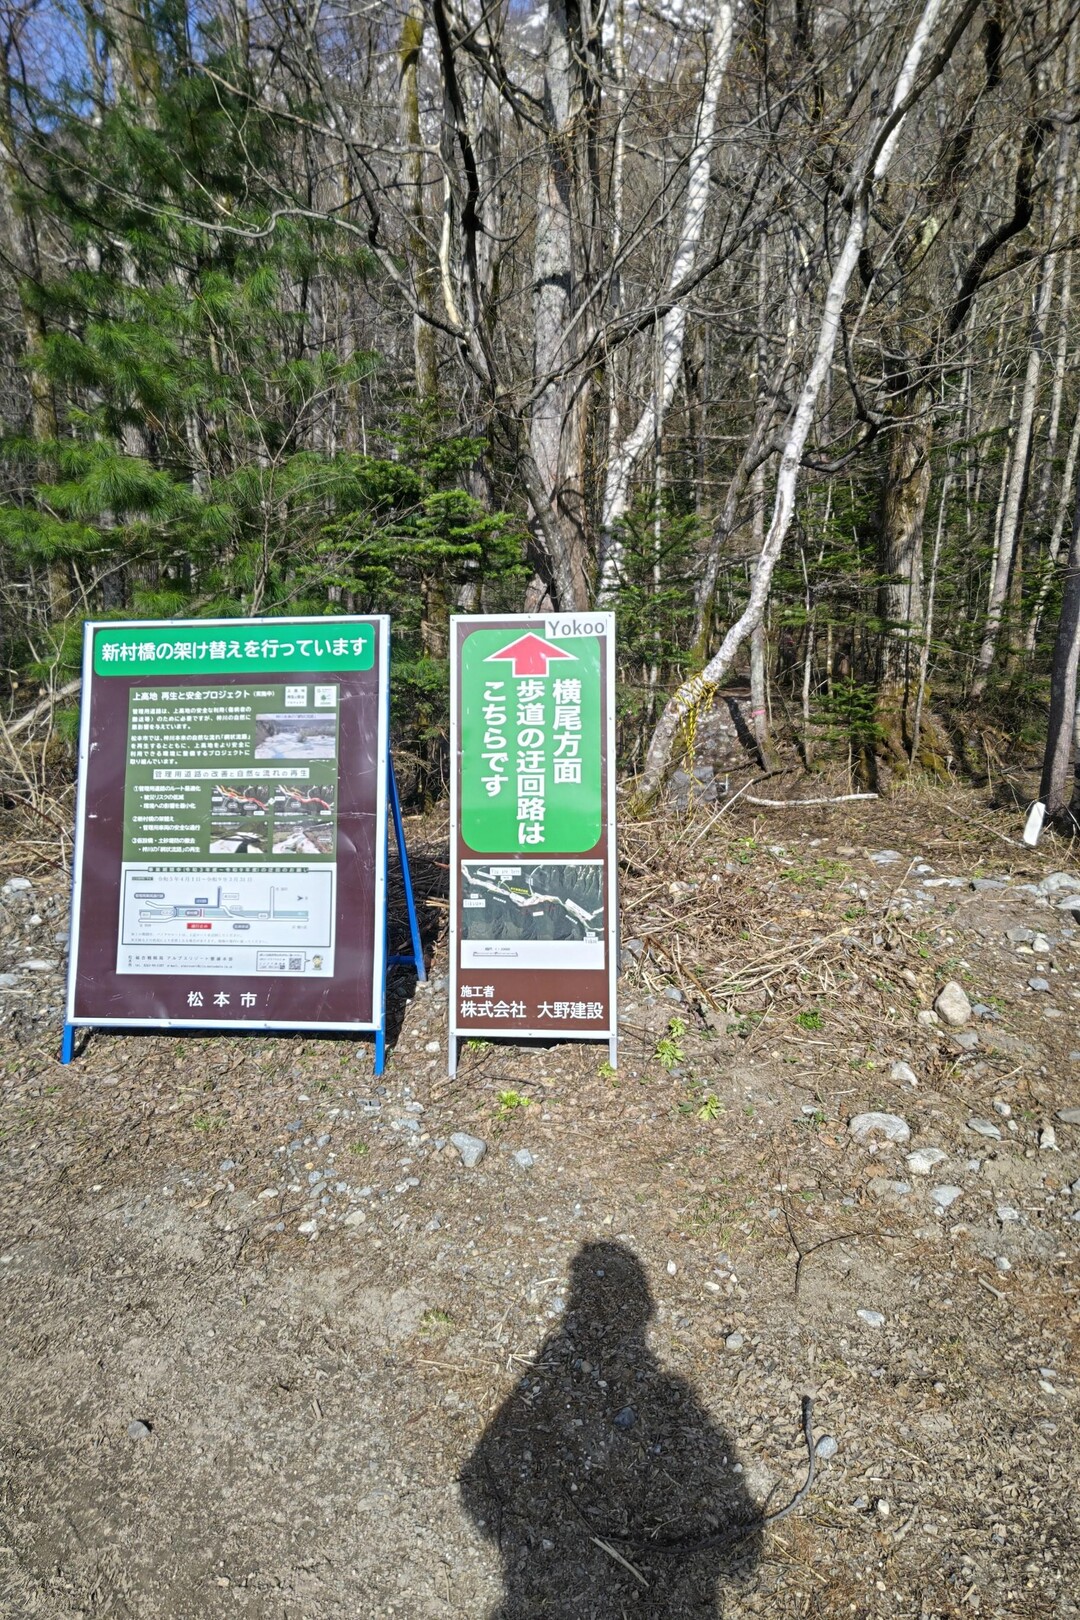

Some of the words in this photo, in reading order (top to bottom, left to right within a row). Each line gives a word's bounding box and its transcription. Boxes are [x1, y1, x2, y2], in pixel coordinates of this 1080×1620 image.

[547, 619, 605, 637] Yokoo
[101, 637, 367, 662] 新村橋の架け替えを行っています
[132, 692, 158, 701] 上高地
[161, 690, 250, 701] 再生と安全プロジェクト
[481, 681, 508, 797] こちらです
[552, 678, 582, 784] 横尾方面
[516, 679, 546, 845] 歩道の迂回路は
[187, 990, 258, 1009] 松本市
[460, 985, 495, 998] 施工者
[460, 1000, 527, 1019] 株式会社
[537, 1001, 604, 1020] 大野建設
